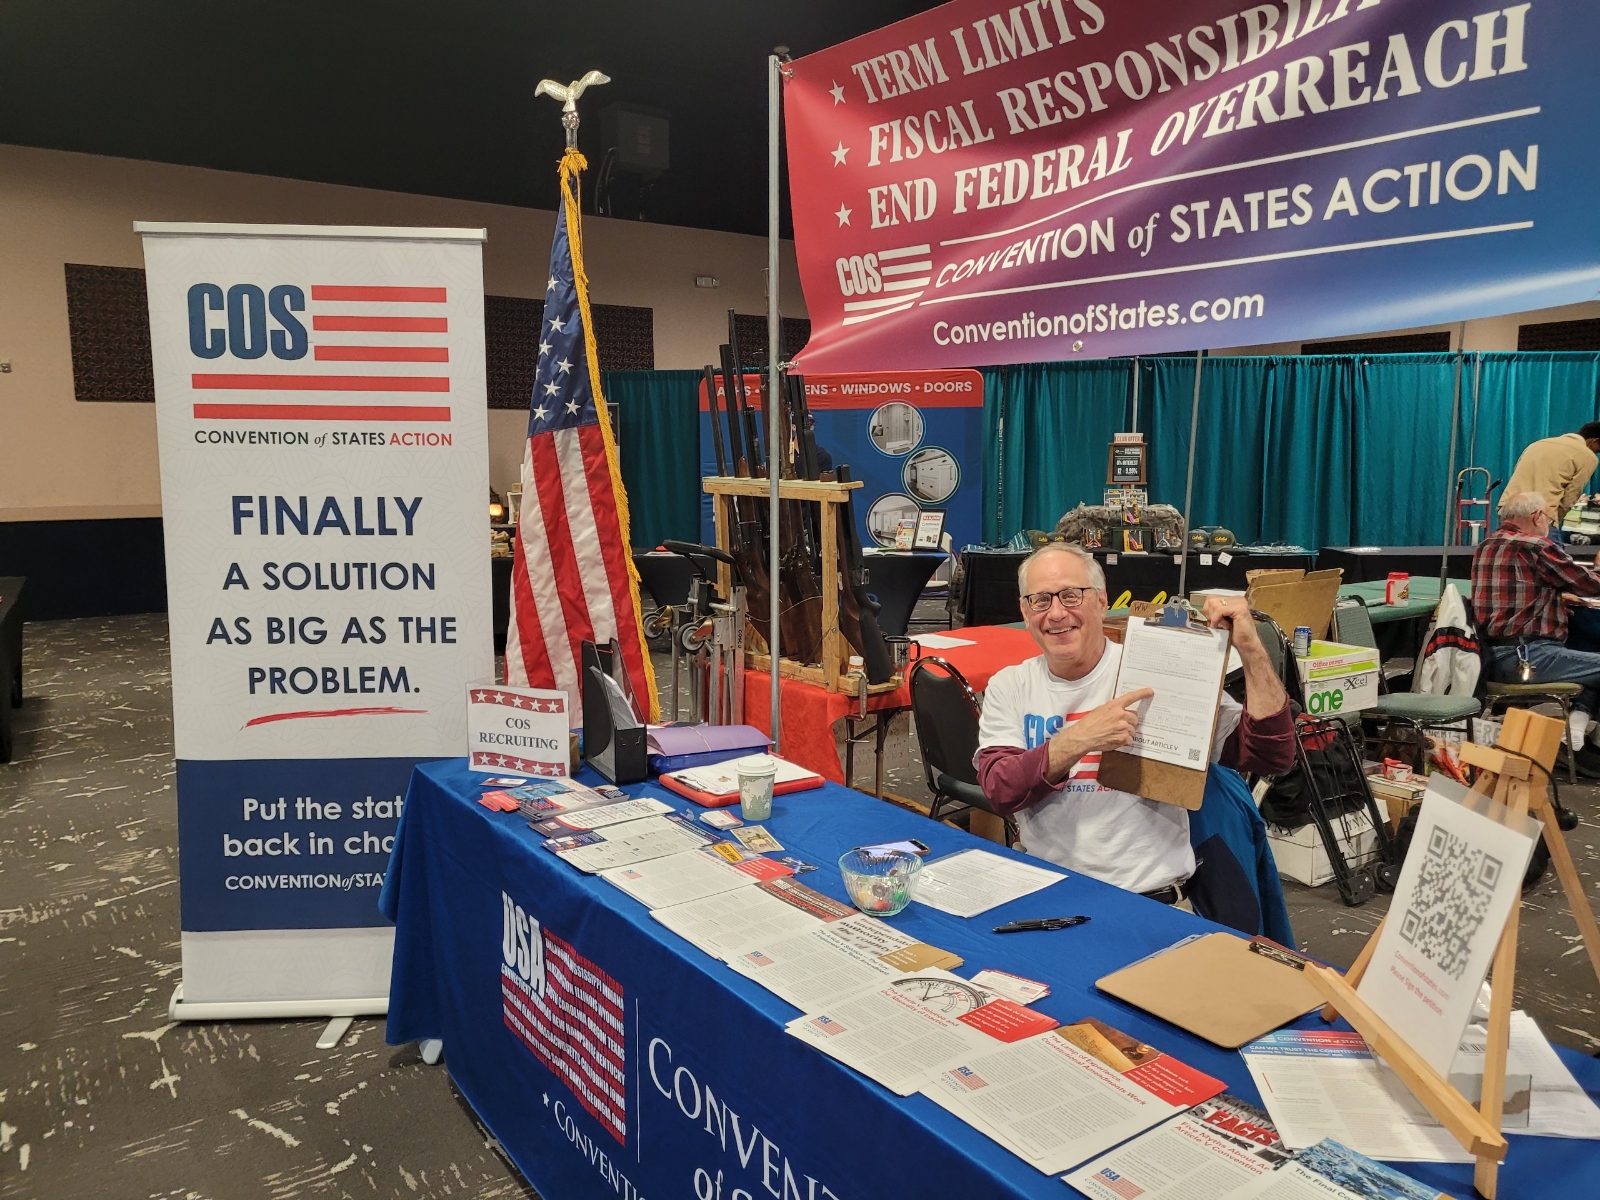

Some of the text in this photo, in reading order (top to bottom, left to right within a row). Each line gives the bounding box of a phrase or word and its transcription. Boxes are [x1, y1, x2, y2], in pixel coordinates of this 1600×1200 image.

[851, 0, 1105, 104] TERM LIMITS
[868, 3, 1532, 229] END FEDERAL OVERREACH
[867, 100, 994, 167] FISCAL
[935, 145, 1538, 288] CONVENTION of STATES ACTION
[836, 253, 882, 296] COS
[187, 283, 308, 360] COS
[934, 294, 1264, 346] ConventionofStates.com
[841, 383, 911, 395] WINDOWS
[923, 381, 972, 393] DOORS
[195, 431, 452, 448] CONVENTION of STATES ACTION
[232, 496, 423, 536] FINALLY
[223, 562, 435, 590] A SOLUTION
[206, 616, 457, 645] AS BIG AS THE
[248, 666, 420, 694] PROBLEM.
[1309, 689, 1343, 714] one
[505, 717, 531, 730] COS
[479, 732, 558, 750] RECRUITING
[1151, 740, 1173, 750] ARTICLE
[1066, 785, 1095, 793] STATES
[243, 796, 403, 821] Put the stat
[223, 832, 301, 857] back
[309, 831, 334, 855] in
[225, 874, 341, 891] CONVENTION
[341, 873, 356, 891] of
[502, 890, 545, 998] USA
[598, 1002, 625, 1037] WYOMING
[816, 1015, 832, 1025] USA
[607, 1035, 626, 1061] TEXAS
[1049, 1035, 1062, 1044] The
[1061, 1043, 1078, 1055] Lamp
[1277, 1036, 1331, 1044] CONVENTION
[595, 1049, 626, 1086] KENTUCKY
[957, 1066, 973, 1076] USA
[1082, 1065, 1127, 1093] Amendments
[1127, 1092, 1147, 1106] Work
[586, 1088, 611, 1122] GEORGIA
[611, 1113, 626, 1136] OHIO
[1204, 1110, 1280, 1146] FACTS
[1174, 1126, 1202, 1143] Article
[1212, 1146, 1263, 1175] Convention
[1181, 1121, 1198, 1133] Five
[1199, 1132, 1227, 1149] Myths
[1228, 1147, 1257, 1164] About
[1100, 1167, 1120, 1181] USA
[1295, 1167, 1311, 1179] The
[1313, 1178, 1337, 1193] Final
